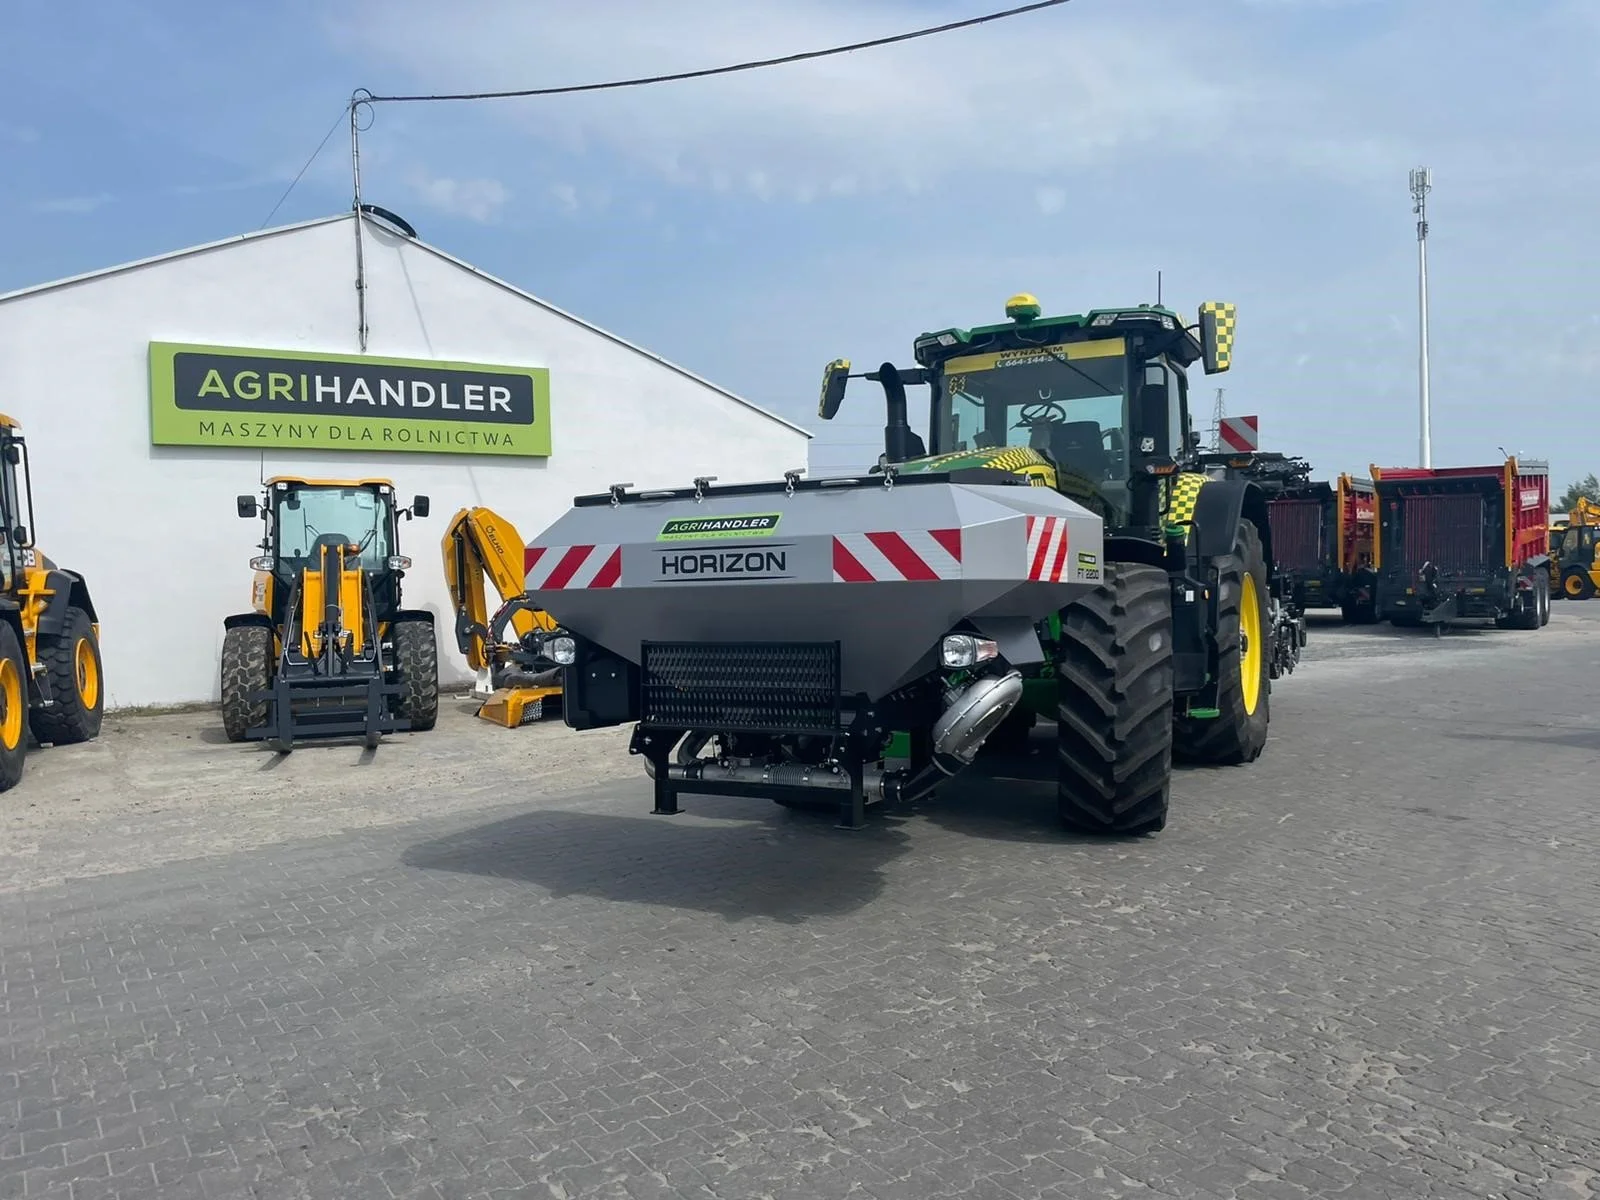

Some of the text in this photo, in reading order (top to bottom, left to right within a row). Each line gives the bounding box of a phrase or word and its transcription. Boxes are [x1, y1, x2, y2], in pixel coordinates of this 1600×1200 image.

[197, 368, 513, 413] AGRIHANDLER
[199, 421, 514, 447] MASZYNY DLA ROLNICTWA
[668, 518, 770, 532] AGRIHANDLER
[661, 552, 786, 575] HORIZON
